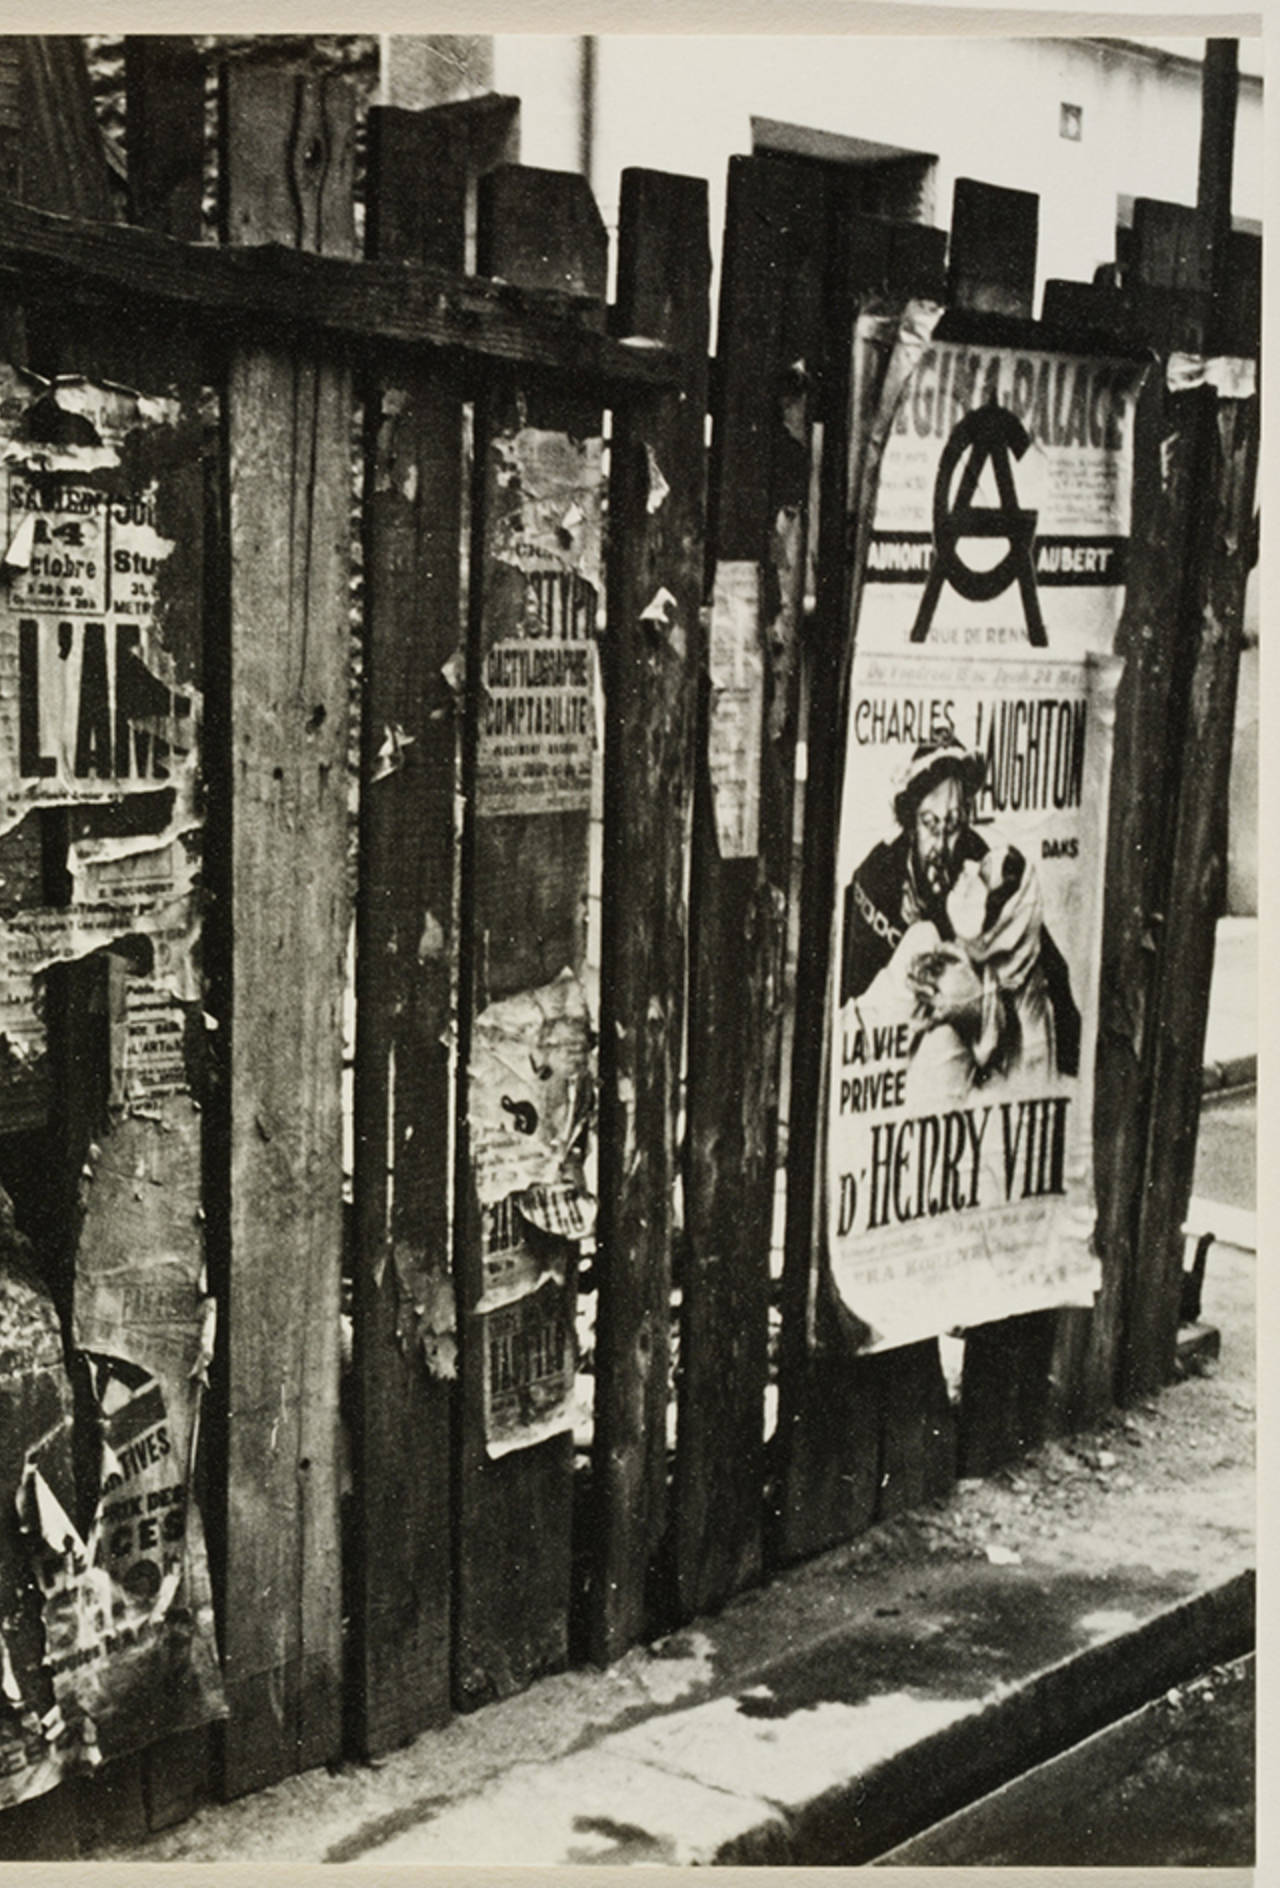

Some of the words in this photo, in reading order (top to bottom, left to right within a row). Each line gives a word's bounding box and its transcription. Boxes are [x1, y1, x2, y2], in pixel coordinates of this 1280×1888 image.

[29, 552, 97, 580] ctobre
[1036, 546, 1114, 572] AUBERT
[854, 699, 955, 746] CHARLES
[972, 699, 1088, 826] LAUGHTON
[1040, 838, 1080, 859] DANS
[841, 1030, 867, 1067] LA
[872, 1023, 910, 1062] VIE
[836, 1104, 991, 1238] D'HENRY
[1000, 1096, 1072, 1202] VIII
